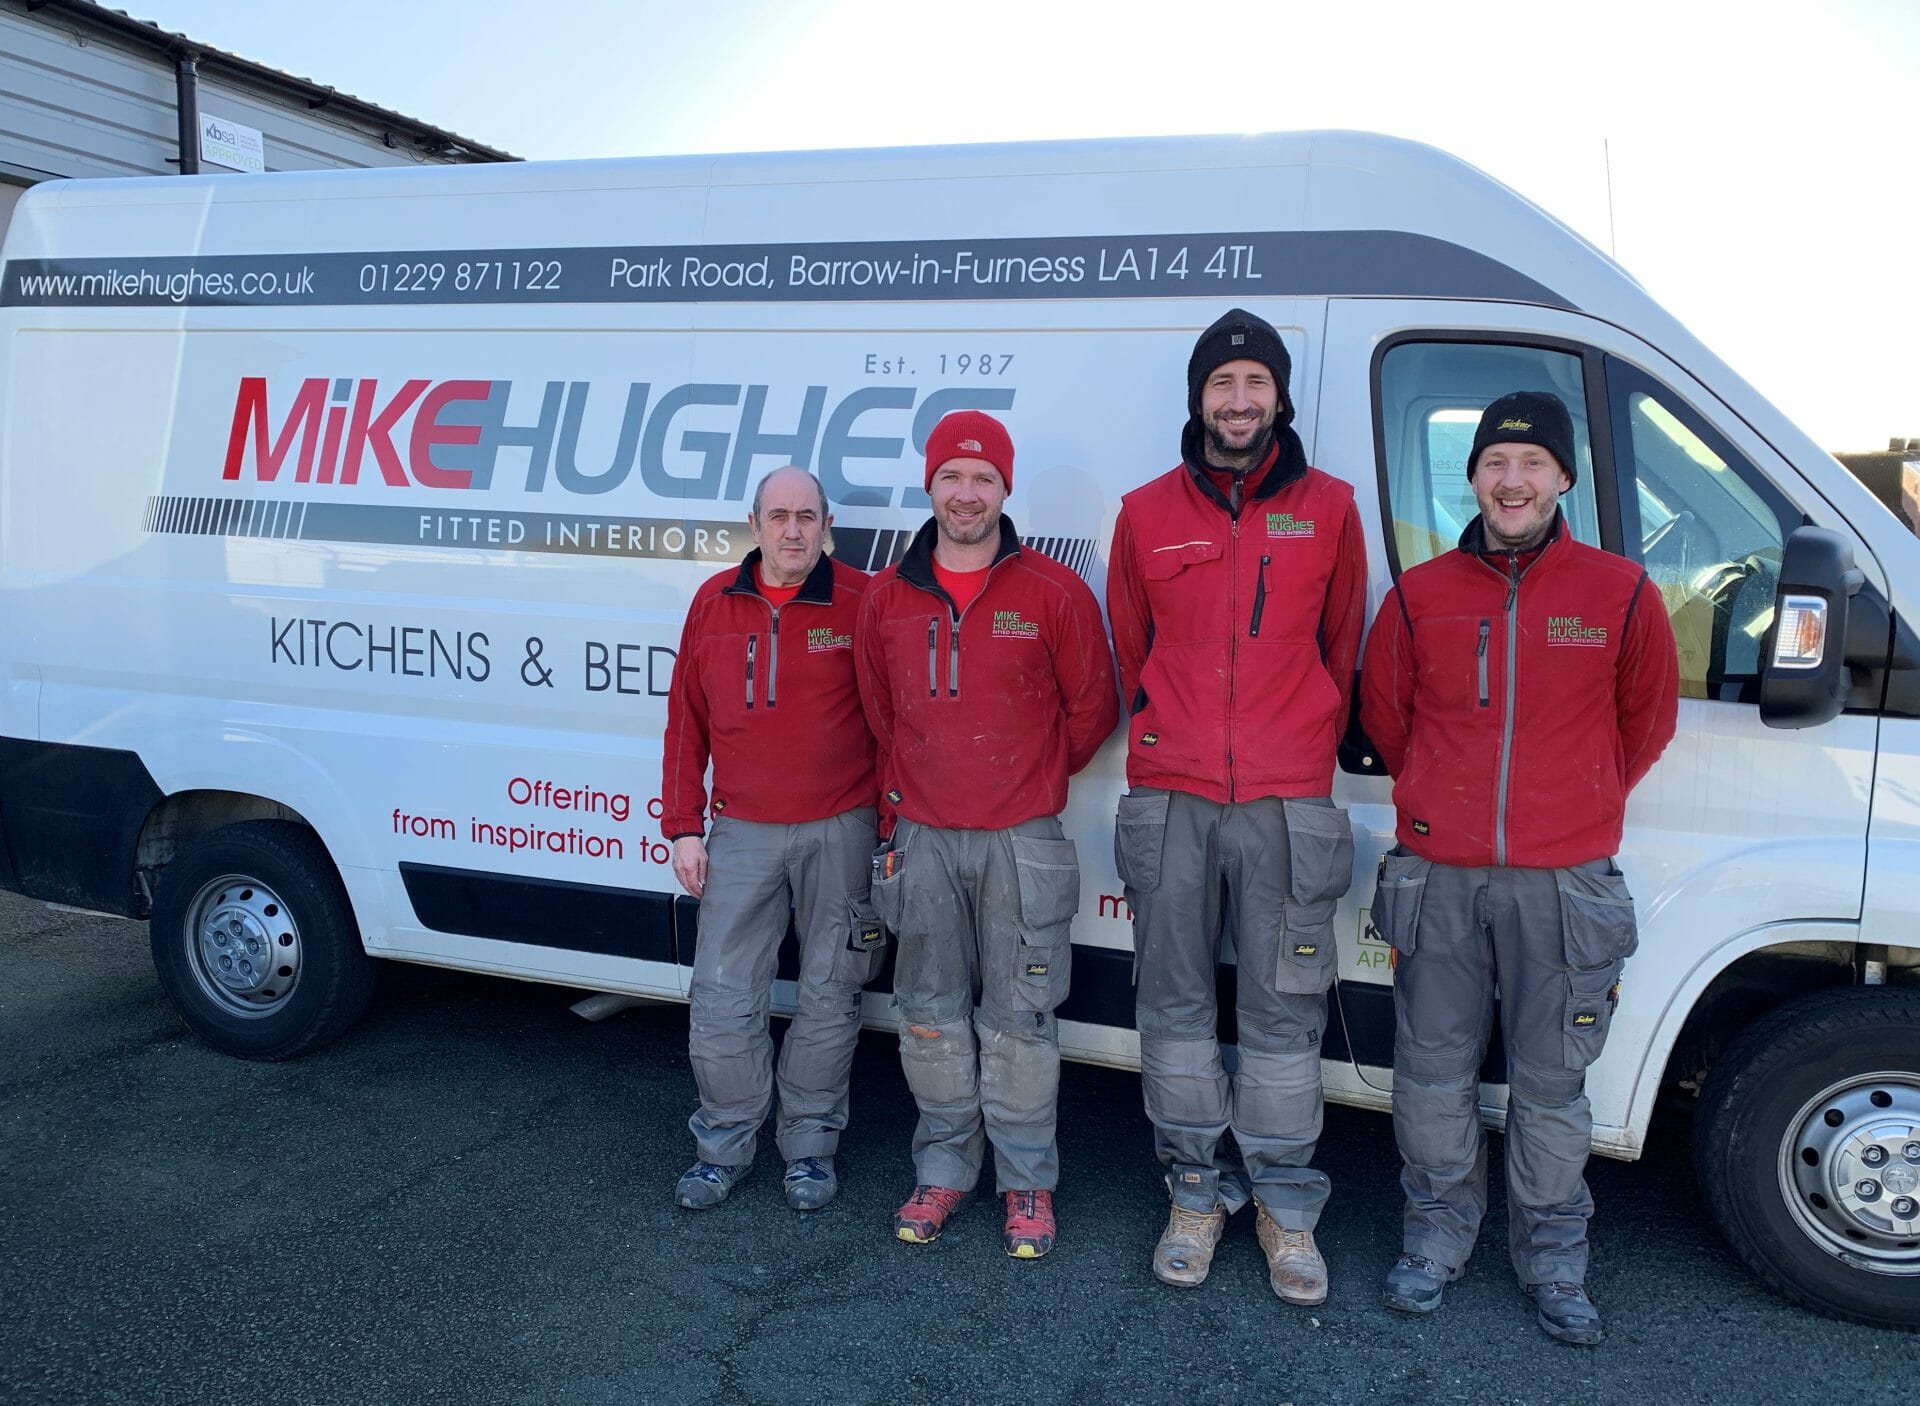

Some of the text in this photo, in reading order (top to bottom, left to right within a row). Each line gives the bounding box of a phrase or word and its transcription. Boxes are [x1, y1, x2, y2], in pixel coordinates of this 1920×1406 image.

[205, 145, 263, 169] APPROVED
[19, 245, 1262, 302] www.mikehughes.co.uk 01229 871122 Park Road, Barrow-in-Furness LA14 4TL
[865, 353, 1015, 376] Est. 1987
[1266, 513, 1294, 522] MIKE
[1267, 521, 1315, 531] HUGHES
[419, 515, 732, 556] FITTED INTERIORS
[994, 611, 1021, 621] MIKE
[993, 621, 1039, 632] HUGHES
[1548, 617, 1582, 627] MIKE
[808, 628, 833, 638] MIKE
[1548, 627, 1608, 638] HUGHES
[808, 635, 852, 646] HUGHES
[270, 616, 490, 682] KITCHENS
[520, 636, 554, 688] &
[507, 777, 630, 822] Offering
[393, 808, 670, 865] from inspiration to
